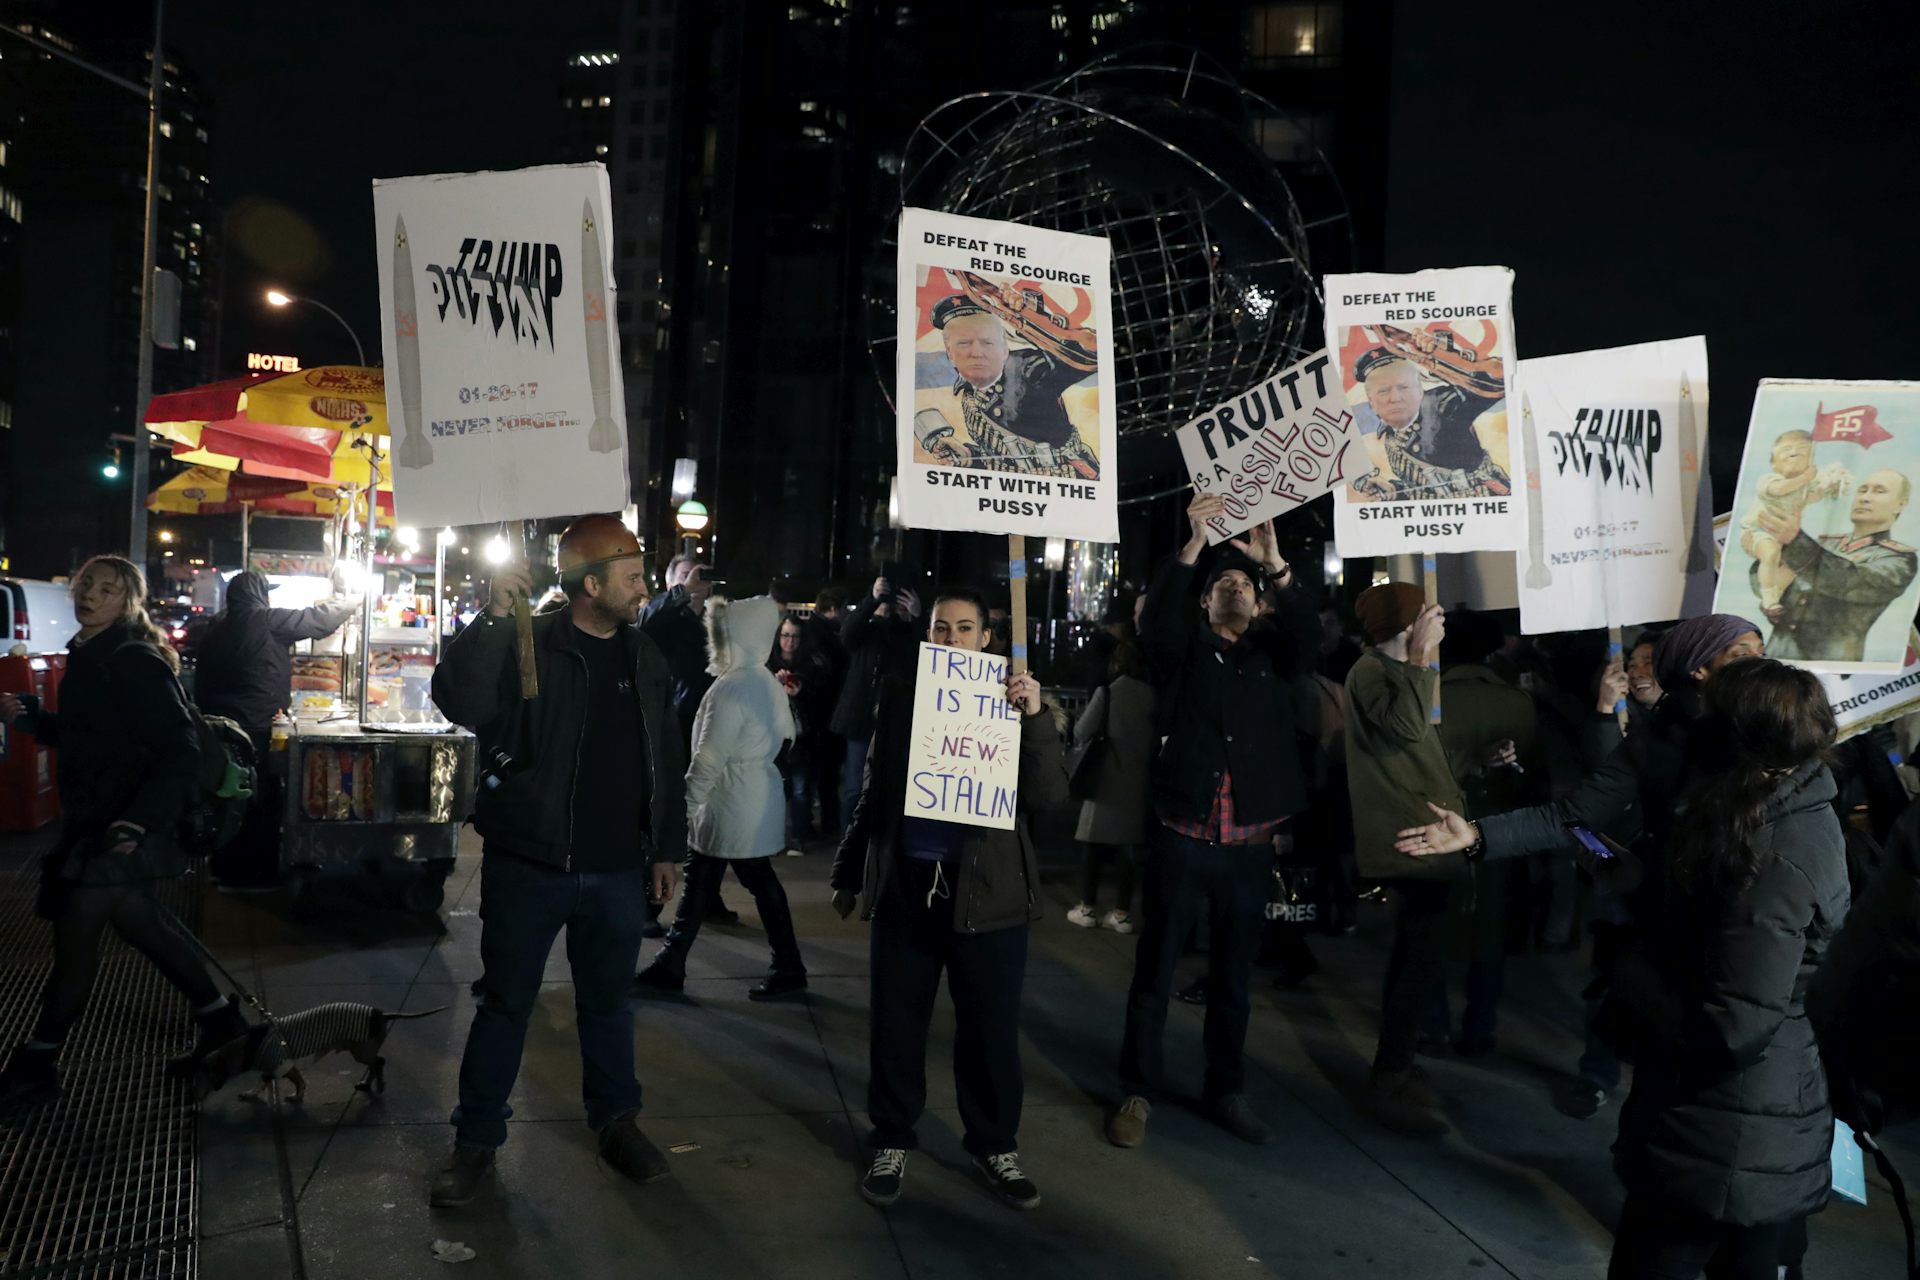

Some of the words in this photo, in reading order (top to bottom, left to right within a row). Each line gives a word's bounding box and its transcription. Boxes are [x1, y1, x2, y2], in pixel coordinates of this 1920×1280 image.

[923, 232, 989, 252] DEFEAT
[994, 243, 1027, 259] THE
[970, 257, 1005, 273] RED
[1010, 263, 1092, 286] SCOURGE
[455, 237, 563, 335] TRUMP
[1343, 293, 1401, 306] DEFEAT
[1405, 291, 1436, 303] THE
[1385, 309, 1416, 321] RED
[1421, 305, 1497, 320] SCOURGE
[247, 352, 302, 372] HOTEL
[459, 382, 538, 404] 01-20-17
[1196, 355, 1329, 460] PRUITT
[431, 417, 491, 437] NEVER
[1271, 407, 1353, 503] FOOL
[1573, 408, 1662, 484] TRUMP
[926, 470, 993, 490] START
[999, 477, 1051, 495] WITH
[1057, 483, 1096, 500] THE
[1193, 473, 1211, 493] IS
[1213, 463, 1231, 482] A
[1206, 423, 1300, 538] FOSSIL
[978, 497, 1048, 517] PUSSY
[1359, 506, 1415, 520] START
[1421, 503, 1467, 517] WITH
[1473, 501, 1509, 514] THE
[1404, 523, 1465, 537] PUSSY
[937, 688, 961, 713] IS
[974, 694, 1018, 721] THE
[941, 735, 998, 762] NEW
[913, 771, 1016, 819] STALIN
